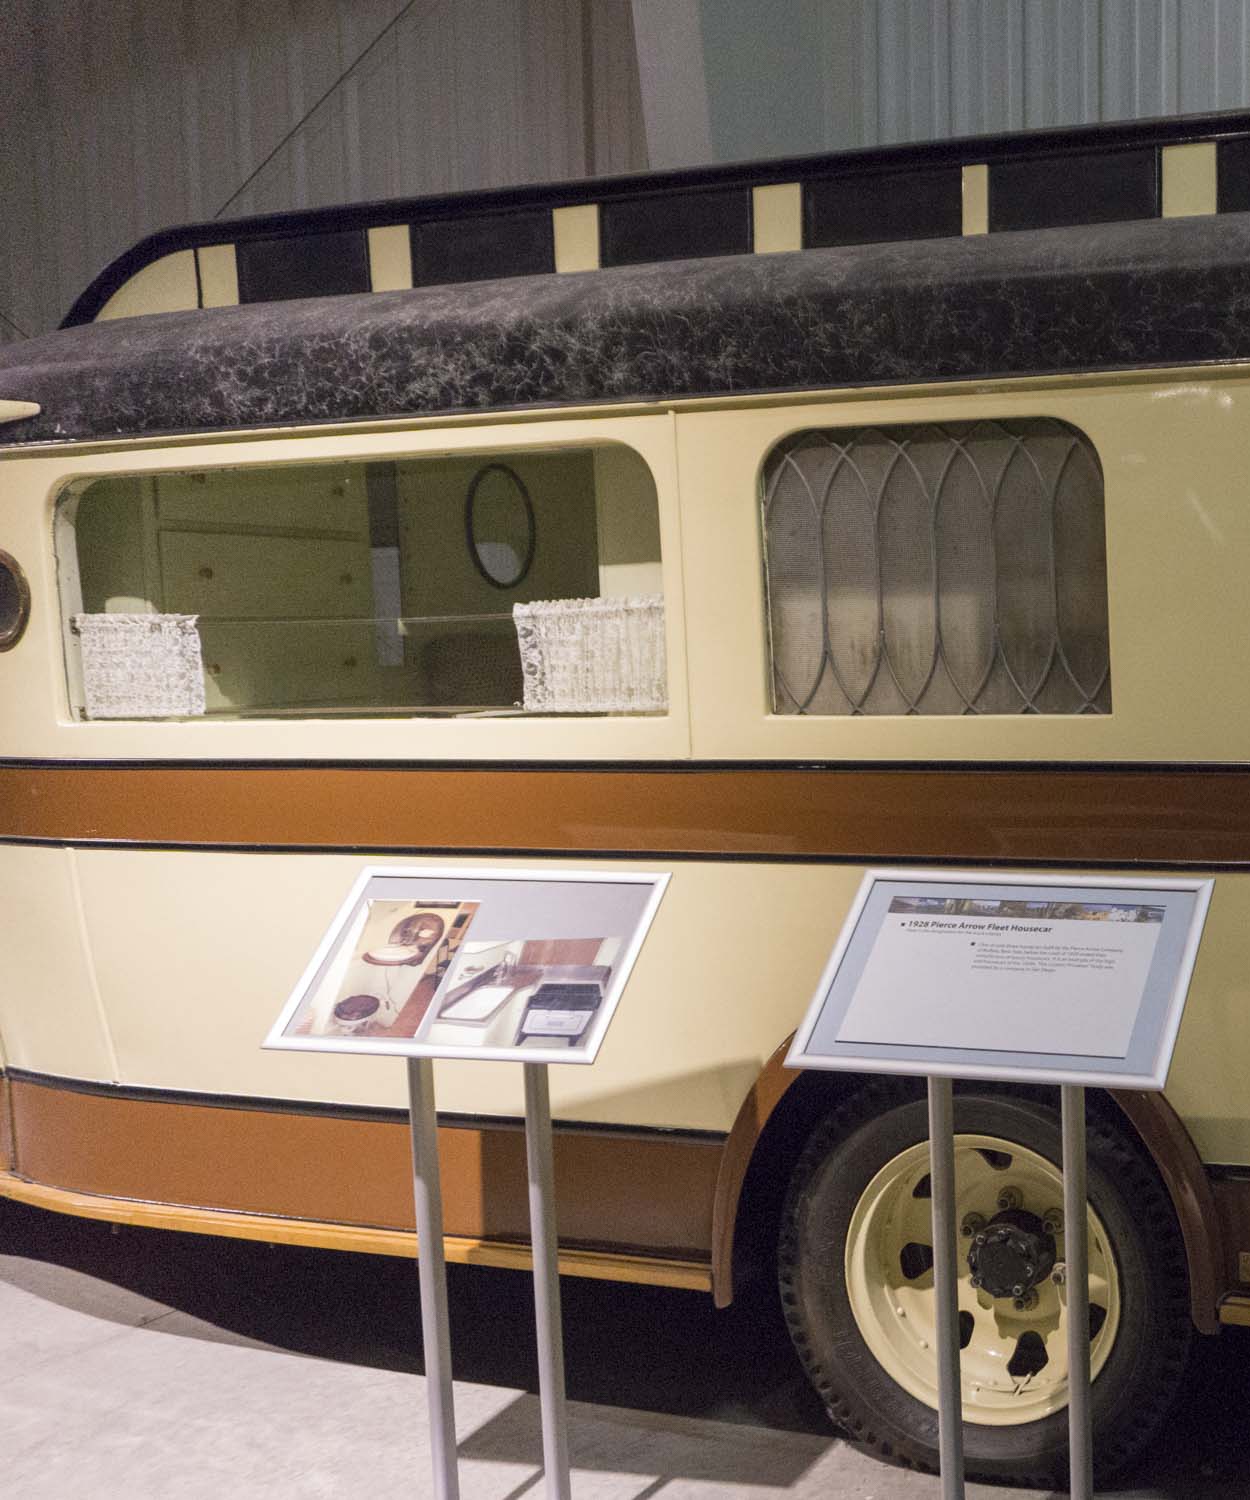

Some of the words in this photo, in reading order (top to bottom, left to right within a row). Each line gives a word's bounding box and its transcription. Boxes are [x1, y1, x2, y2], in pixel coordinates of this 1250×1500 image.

[908, 920, 929, 928] 1928
[930, 921, 957, 929] Pierce
[958, 922, 985, 930] Arrow
[986, 923, 1010, 931] Fleet
[1010, 924, 1053, 933] Housecar
